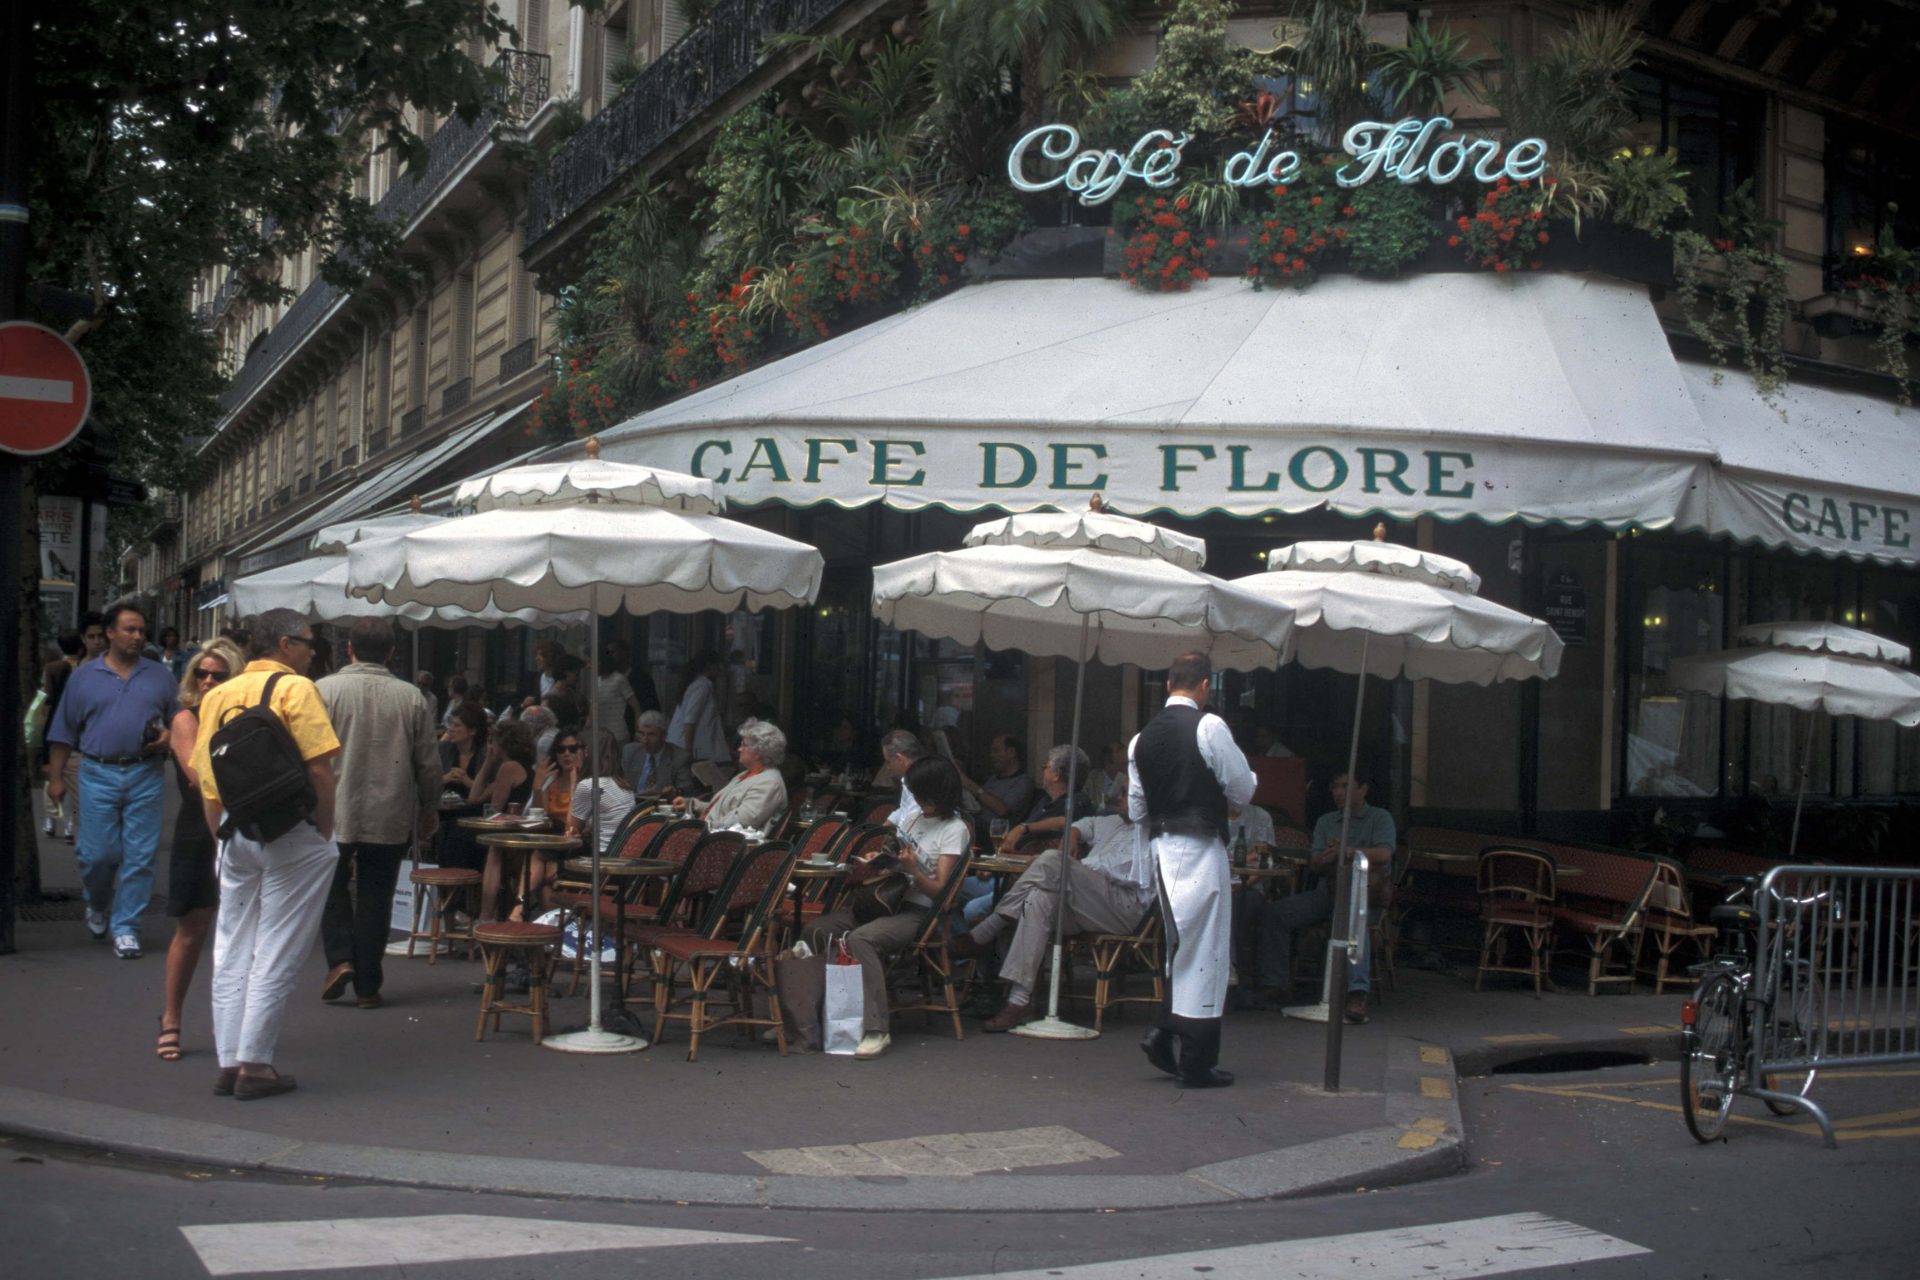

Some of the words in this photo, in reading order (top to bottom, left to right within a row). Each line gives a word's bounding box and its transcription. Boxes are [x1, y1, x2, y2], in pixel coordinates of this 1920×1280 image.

[1007, 122, 1195, 206] Café
[1223, 128, 1302, 187] de
[1335, 116, 1550, 189] Flore
[690, 437, 926, 487] CAFE
[977, 441, 1109, 490] DE
[1157, 444, 1475, 500] FLORE
[1783, 492, 1911, 548] CAFE
